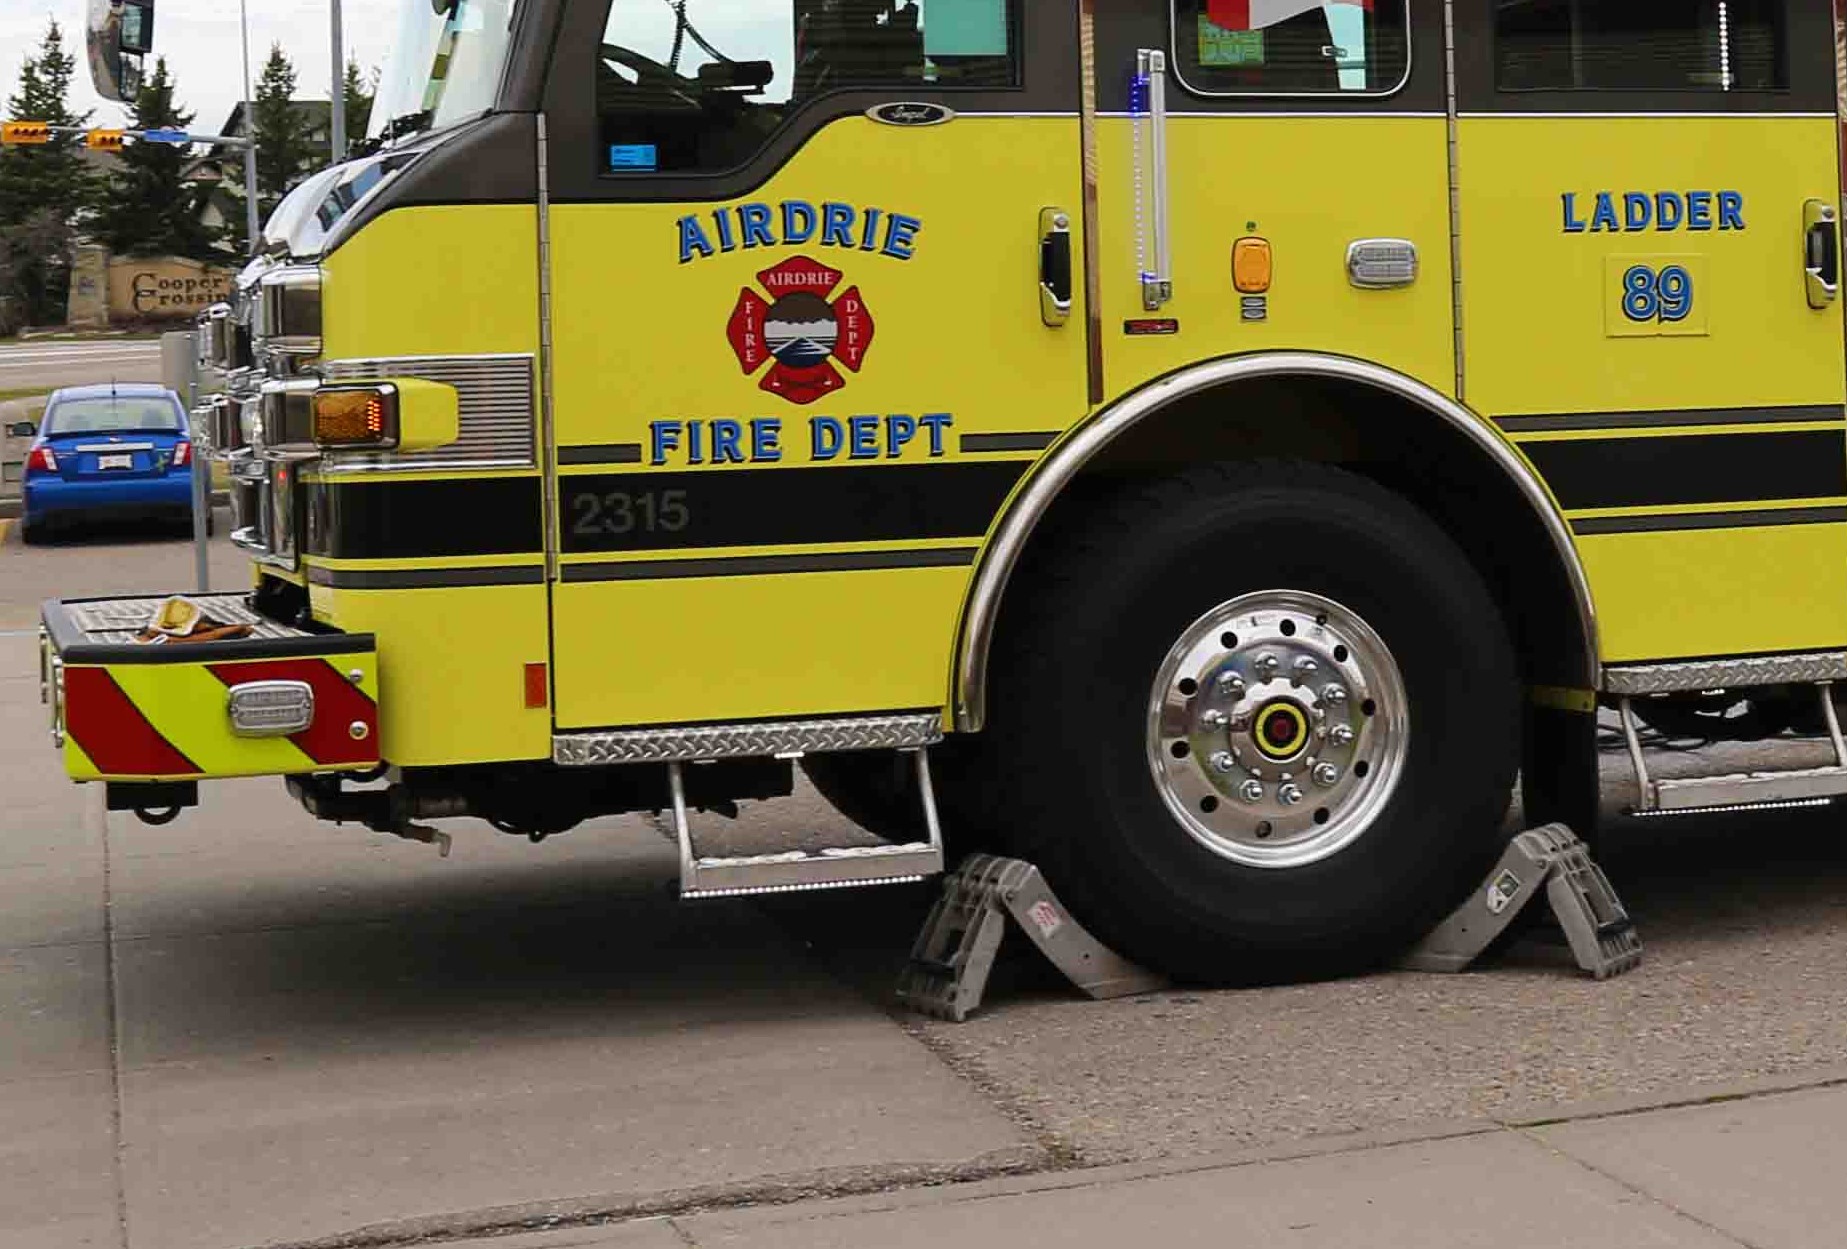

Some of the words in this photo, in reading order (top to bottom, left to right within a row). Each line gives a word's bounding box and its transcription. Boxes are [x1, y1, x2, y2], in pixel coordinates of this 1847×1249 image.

[677, 200, 921, 264] AIRDRIE
[1561, 190, 1745, 233] LADDER
[132, 273, 223, 293] Cooper
[132, 290, 229, 311] Crossin
[766, 271, 835, 286] AIRDRIE
[1622, 265, 1694, 324] 89
[744, 301, 757, 363] FIRE
[845, 299, 860, 360] DEPT
[649, 418, 783, 465] FIRE
[808, 413, 952, 462] DEPT
[574, 490, 689, 533] 2315
